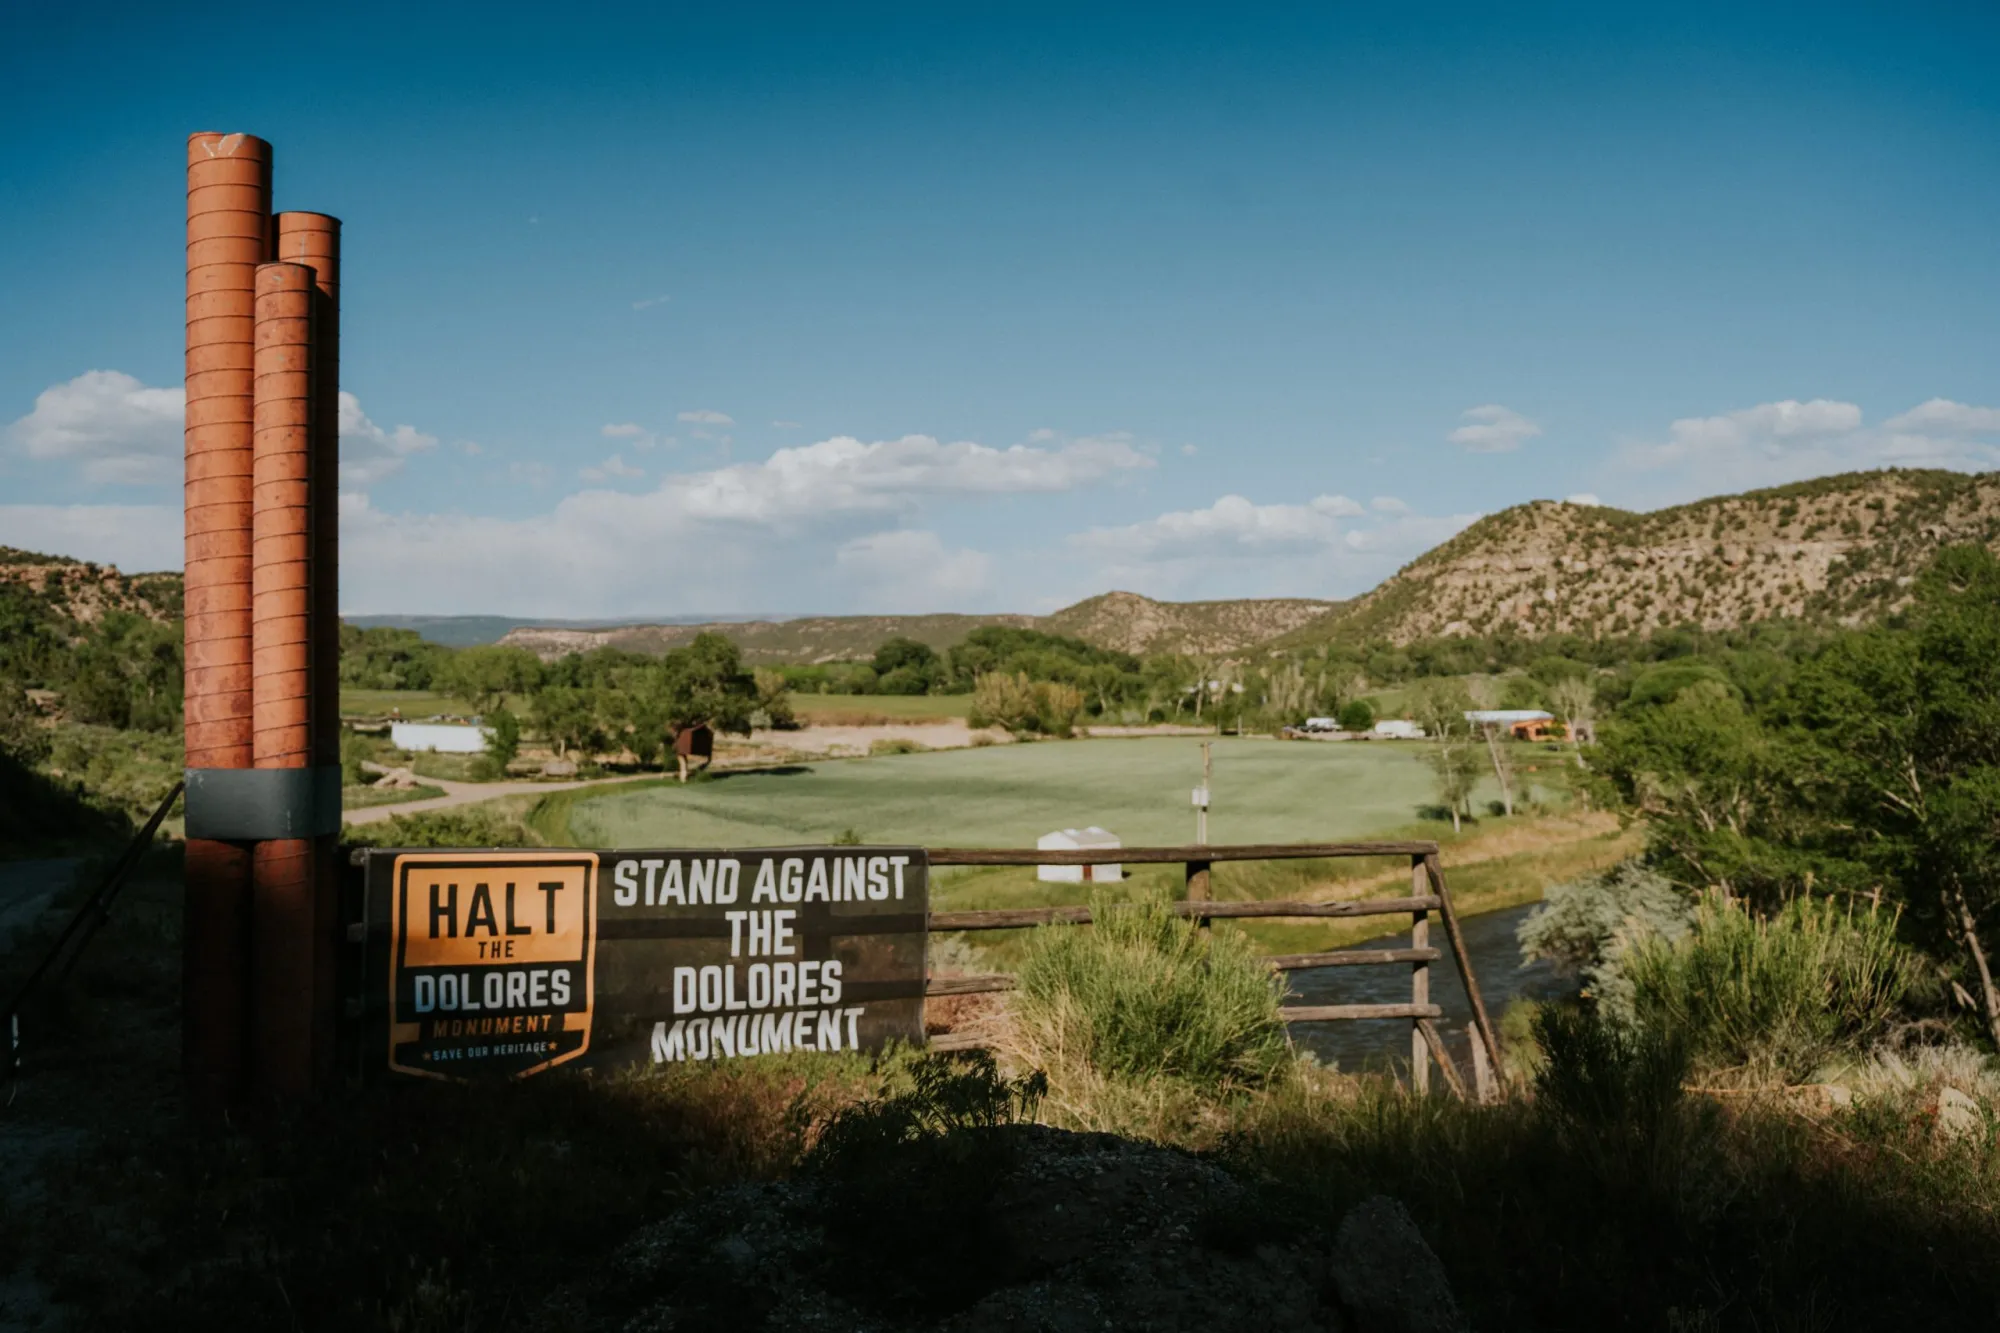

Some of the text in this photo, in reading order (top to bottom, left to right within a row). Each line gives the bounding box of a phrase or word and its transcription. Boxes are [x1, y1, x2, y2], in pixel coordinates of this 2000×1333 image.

[613, 856, 910, 907] STAND AGAINST
[428, 881, 565, 939] HALT
[725, 909, 797, 958] THE
[478, 939, 515, 959] THE
[414, 968, 571, 1013] DOLORES
[673, 960, 843, 1015] DOLORES
[432, 1014, 552, 1038] MONUMENT
[650, 1007, 865, 1064] MONUMENT
[432, 1041, 547, 1061] SAVE OUR HERITAGE
